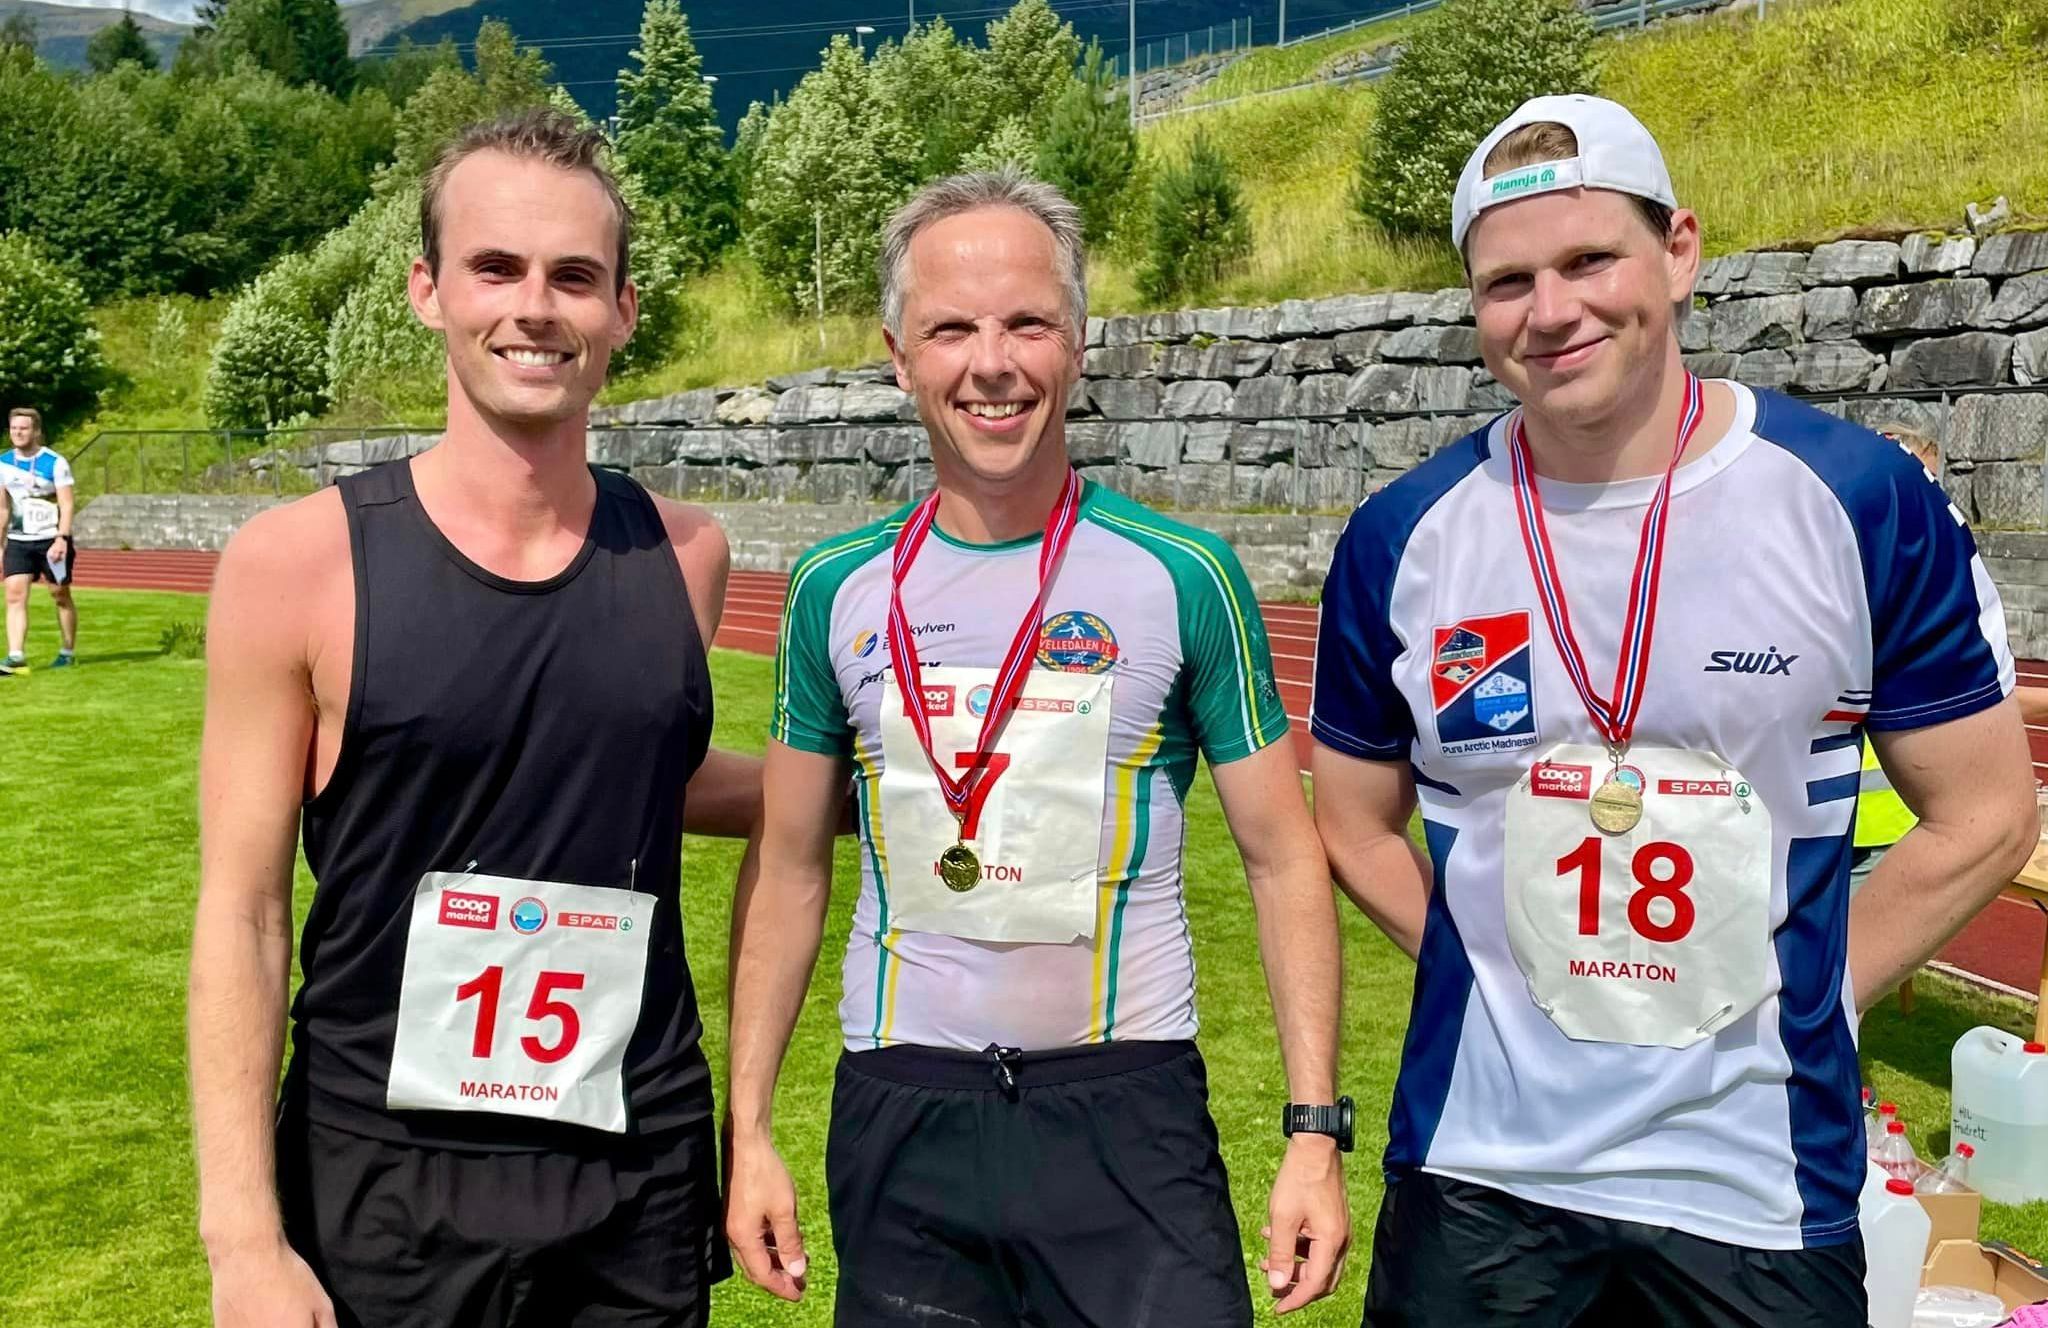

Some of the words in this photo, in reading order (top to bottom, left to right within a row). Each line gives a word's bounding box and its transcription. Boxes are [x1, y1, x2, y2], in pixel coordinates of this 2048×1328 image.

[1040, 638, 1099, 651] VELLEDALEN
[1023, 699, 1073, 711] SPAR
[1441, 744, 1463, 755] Pure
[1464, 740, 1491, 753] Arctic
[1538, 769, 1583, 783] coop
[1538, 781, 1581, 793] marked
[1671, 781, 1732, 794] SPAR
[955, 752, 1011, 840] 7
[934, 861, 1022, 882] MTON
[1556, 837, 1695, 943] 18
[447, 897, 491, 914] coop
[446, 911, 489, 923] marked
[568, 915, 616, 928] SPAR
[1569, 959, 1676, 983] MARATON
[456, 966, 585, 1063] 15
[460, 1081, 558, 1101] MARATON
